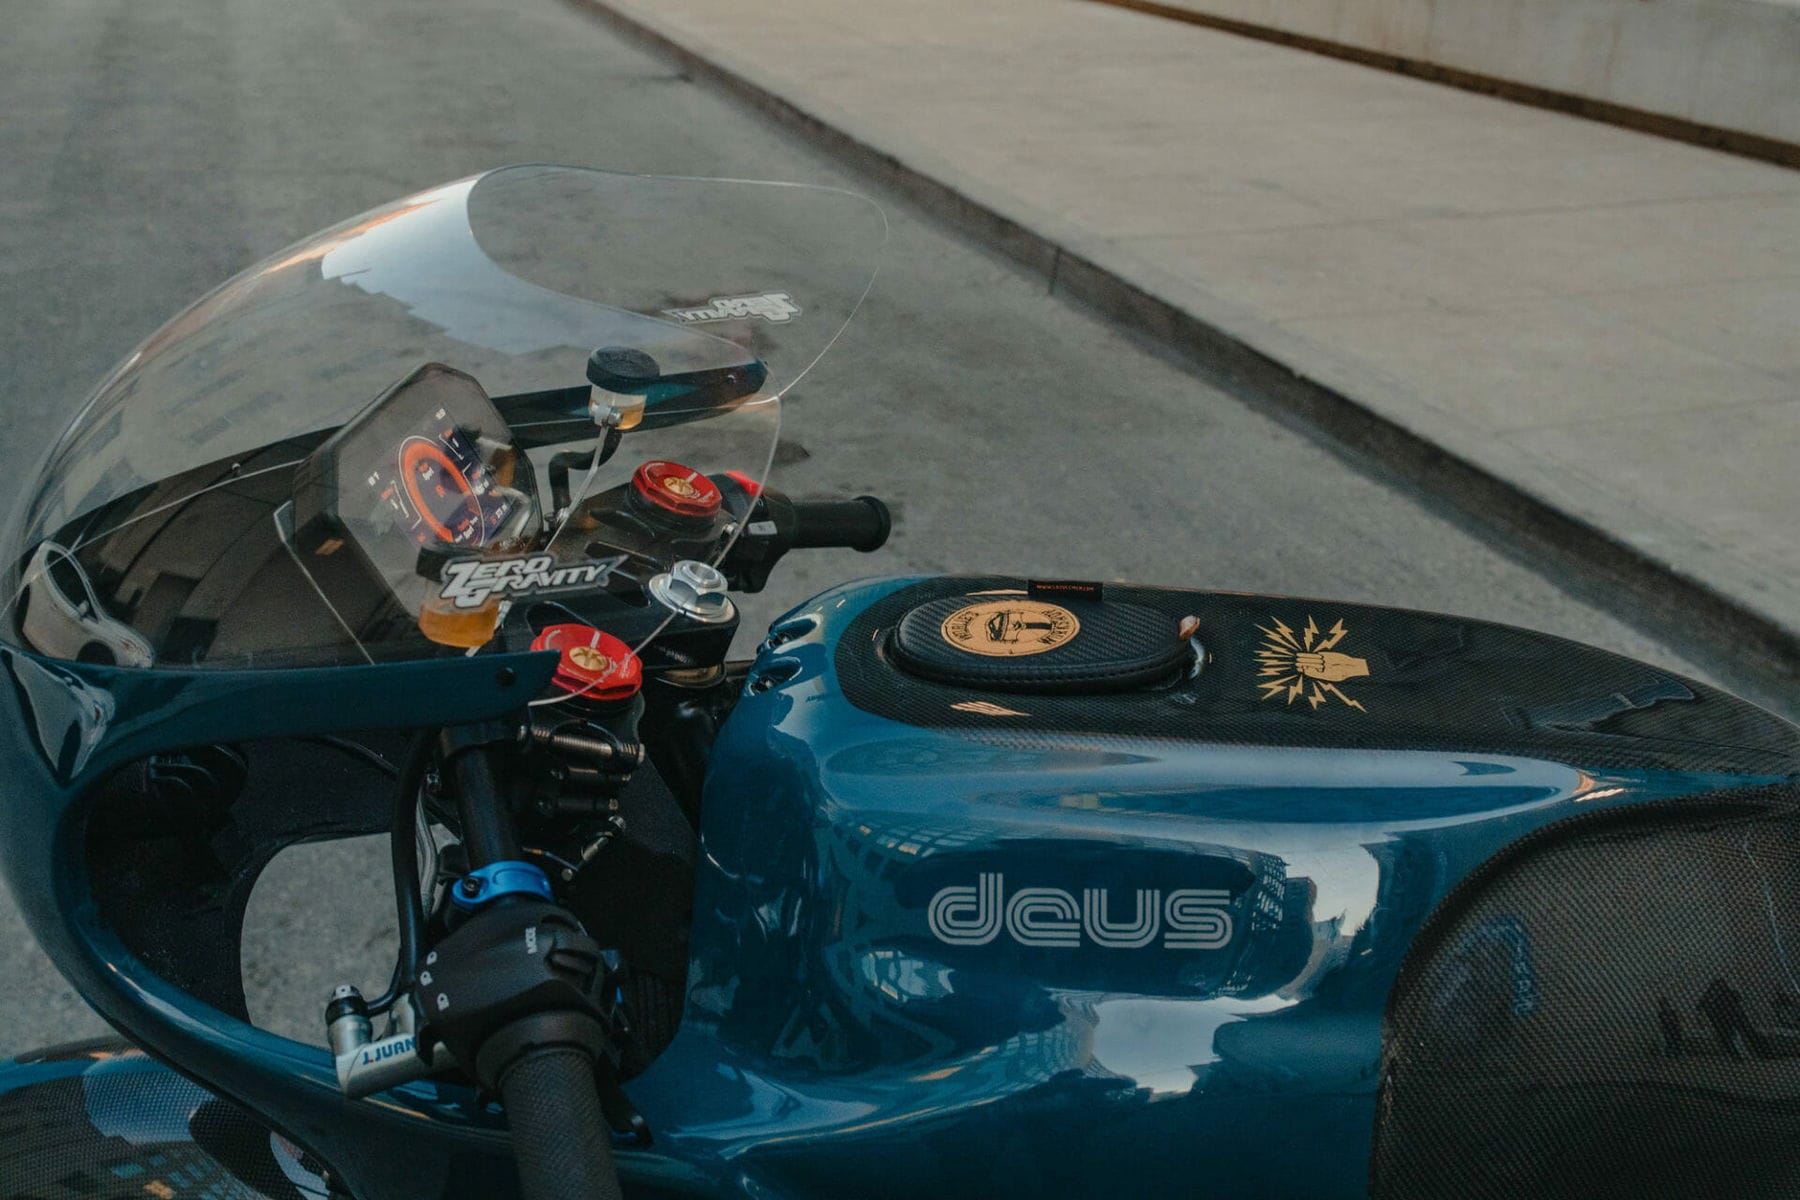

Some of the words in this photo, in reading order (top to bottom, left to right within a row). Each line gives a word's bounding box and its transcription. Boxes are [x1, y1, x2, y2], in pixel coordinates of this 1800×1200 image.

[440, 556, 552, 599] ZERO
[455, 563, 607, 608] GRAVITY
[928, 873, 1233, 949] deus
